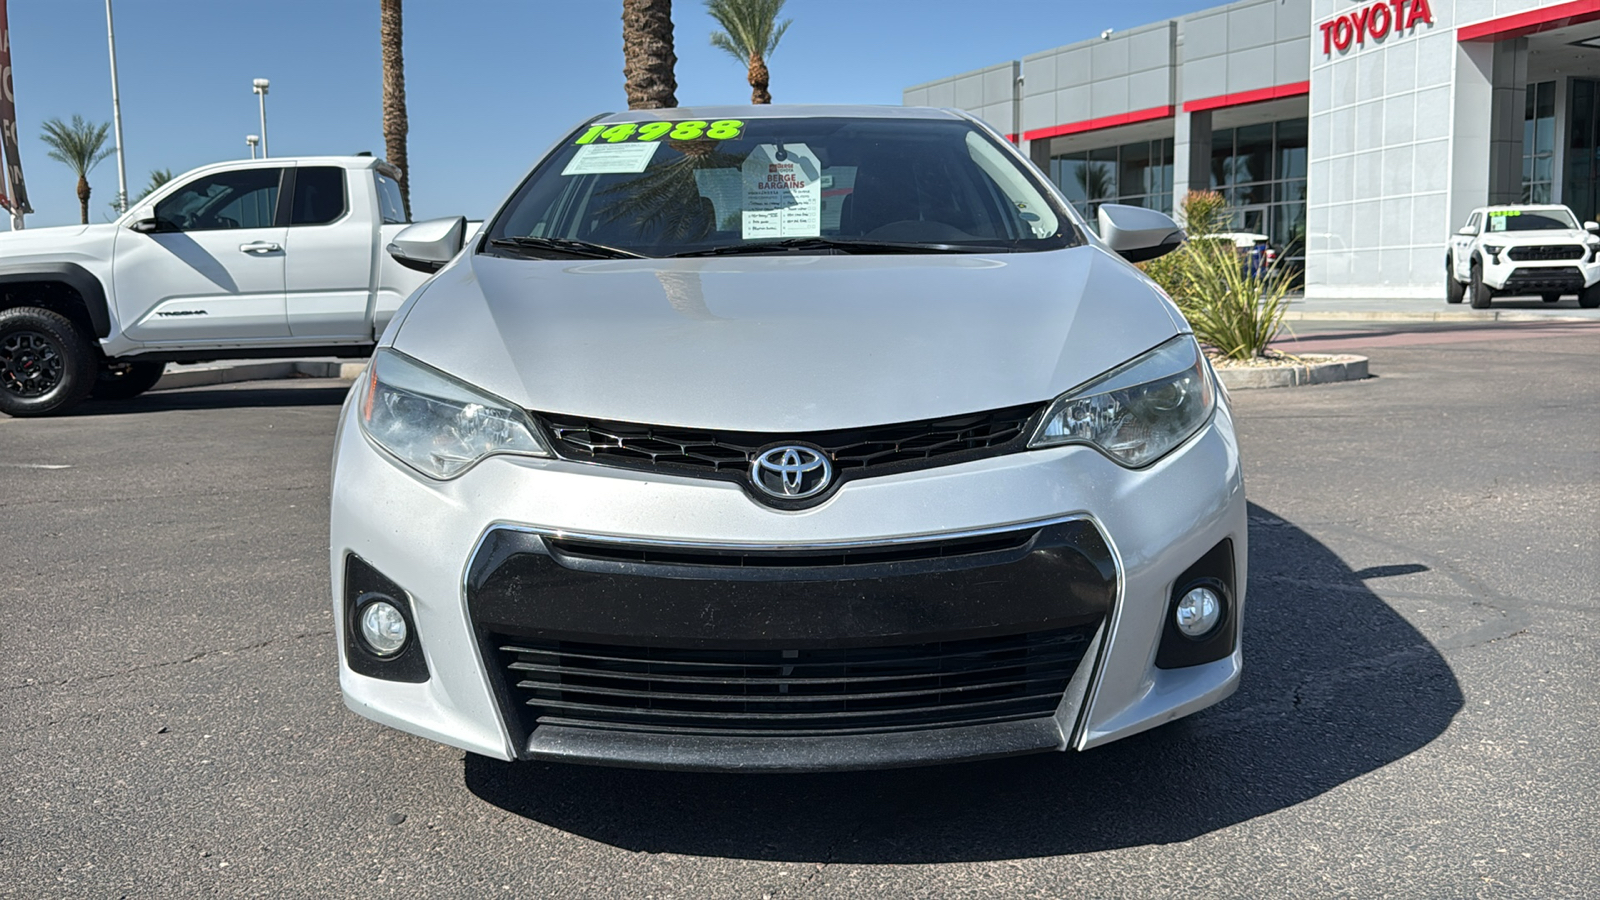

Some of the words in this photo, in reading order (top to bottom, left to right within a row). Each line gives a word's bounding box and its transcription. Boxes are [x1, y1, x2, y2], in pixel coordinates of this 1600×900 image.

[1319, 0, 1432, 54] TOYOTA
[575, 120, 744, 144] 14988
[758, 181, 805, 189] BARGAINS
[767, 174, 796, 182] BERGE
